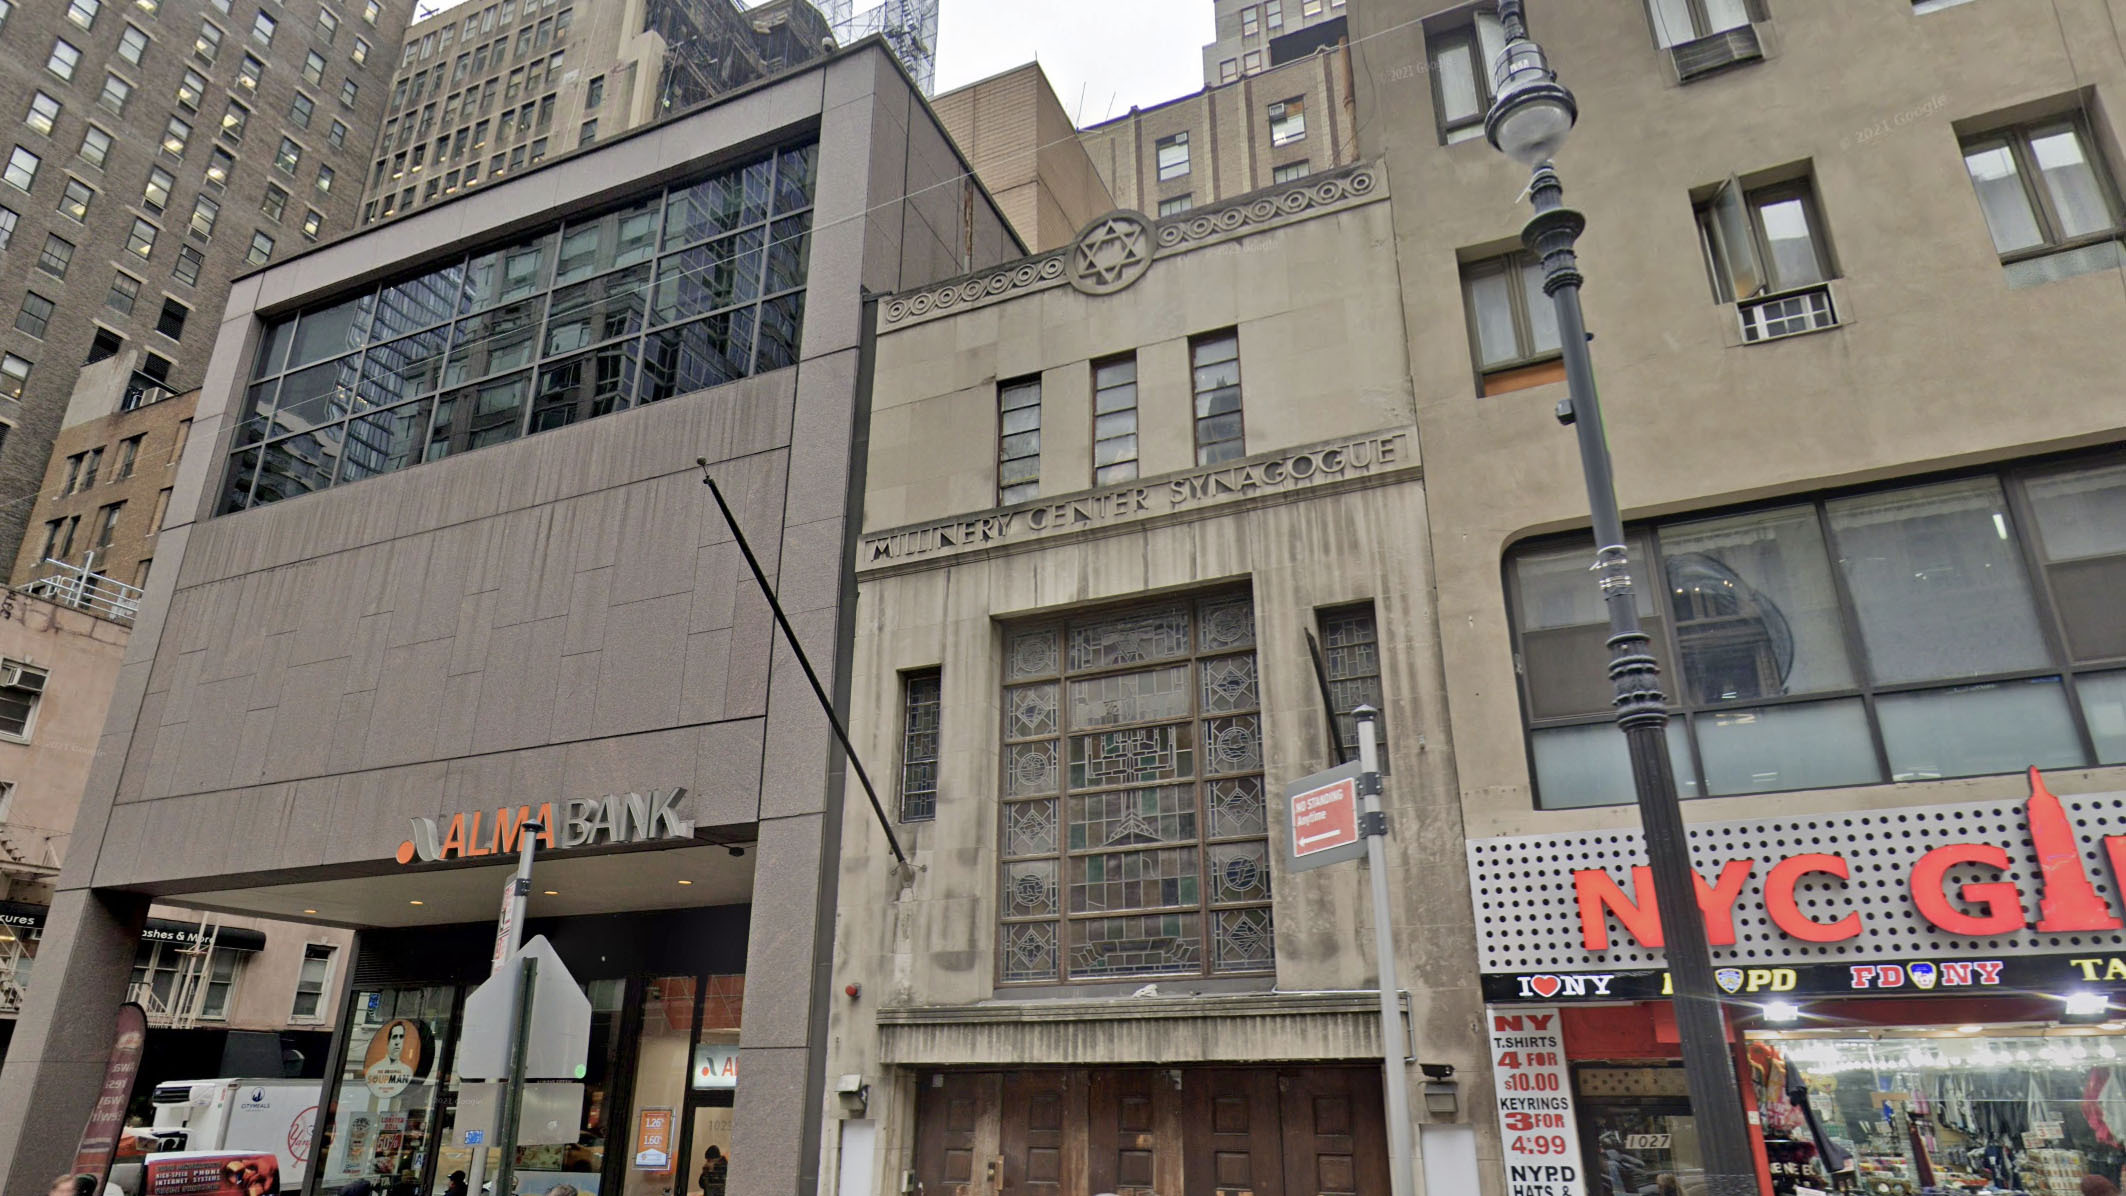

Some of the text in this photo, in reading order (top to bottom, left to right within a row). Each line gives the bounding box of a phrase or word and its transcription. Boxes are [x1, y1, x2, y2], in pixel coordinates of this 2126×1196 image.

[872, 437, 1397, 561] MILLINERY CENTER SYNAGOGUE
[1295, 789, 1344, 813] NO STANDING
[440, 787, 695, 860] ALMA BANK
[1297, 811, 1327, 826] Anytime
[1574, 855, 1862, 952] NYC
[176, 931, 185, 941] &
[1561, 974, 1614, 997] NY
[1494, 1015, 1554, 1032] NY
[1494, 1037, 1558, 1049] T.SHIRTS
[1498, 1052, 1559, 1069] 4 FOR
[368, 1074, 409, 1085] SOUPMAN
[1505, 1073, 1560, 1092] $10.00
[1501, 1097, 1570, 1110] KEYRINGS
[1505, 1112, 1566, 1132] 3 FOR
[1630, 1135, 1671, 1148] 1027
[155, 1178, 189, 1187] INTERNET
